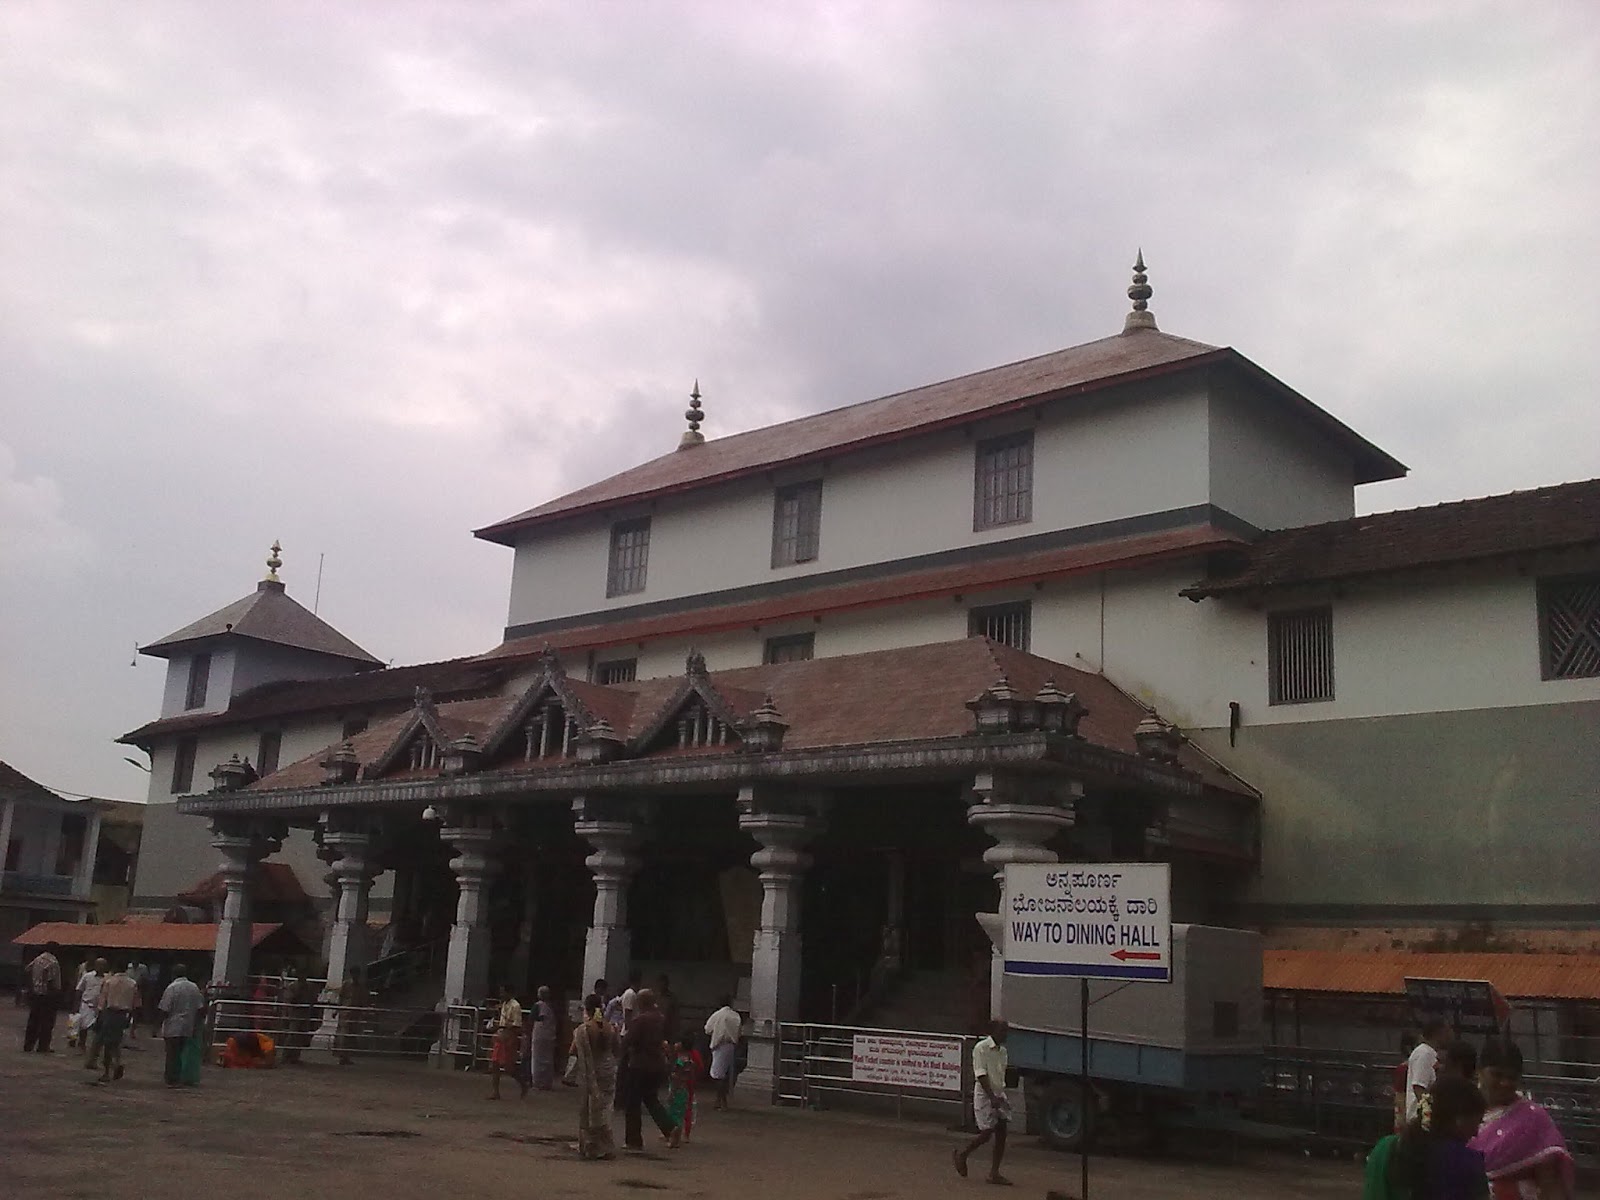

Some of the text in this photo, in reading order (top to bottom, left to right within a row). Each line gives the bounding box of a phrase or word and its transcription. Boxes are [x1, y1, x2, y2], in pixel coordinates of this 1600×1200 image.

[1127, 897, 1158, 915] ದಾರಿ
[1012, 921, 1160, 947] WAY TO DINING HALL
